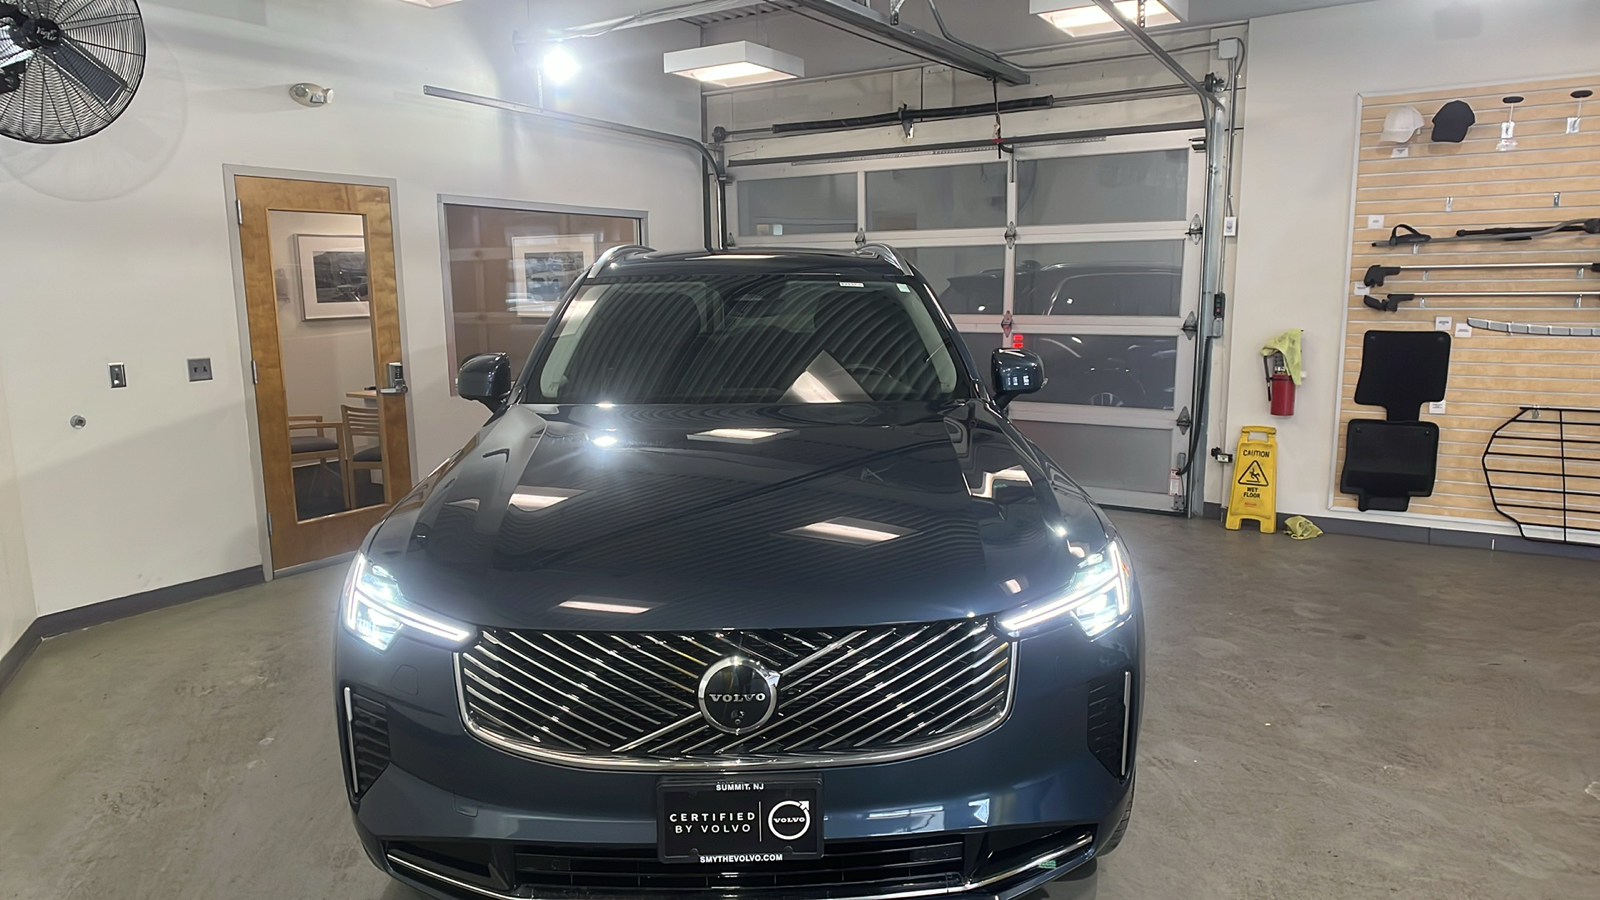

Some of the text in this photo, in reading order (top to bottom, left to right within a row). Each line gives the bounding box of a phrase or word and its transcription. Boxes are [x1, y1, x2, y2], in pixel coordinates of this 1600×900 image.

[1243, 450, 1270, 458] CAUTION
[709, 693, 766, 703] VOLVO
[669, 812, 756, 823] CERTIFIED
[675, 823, 751, 834] BY VOLVO
[699, 854, 783, 863] SMYTHEVOLVO.COM
